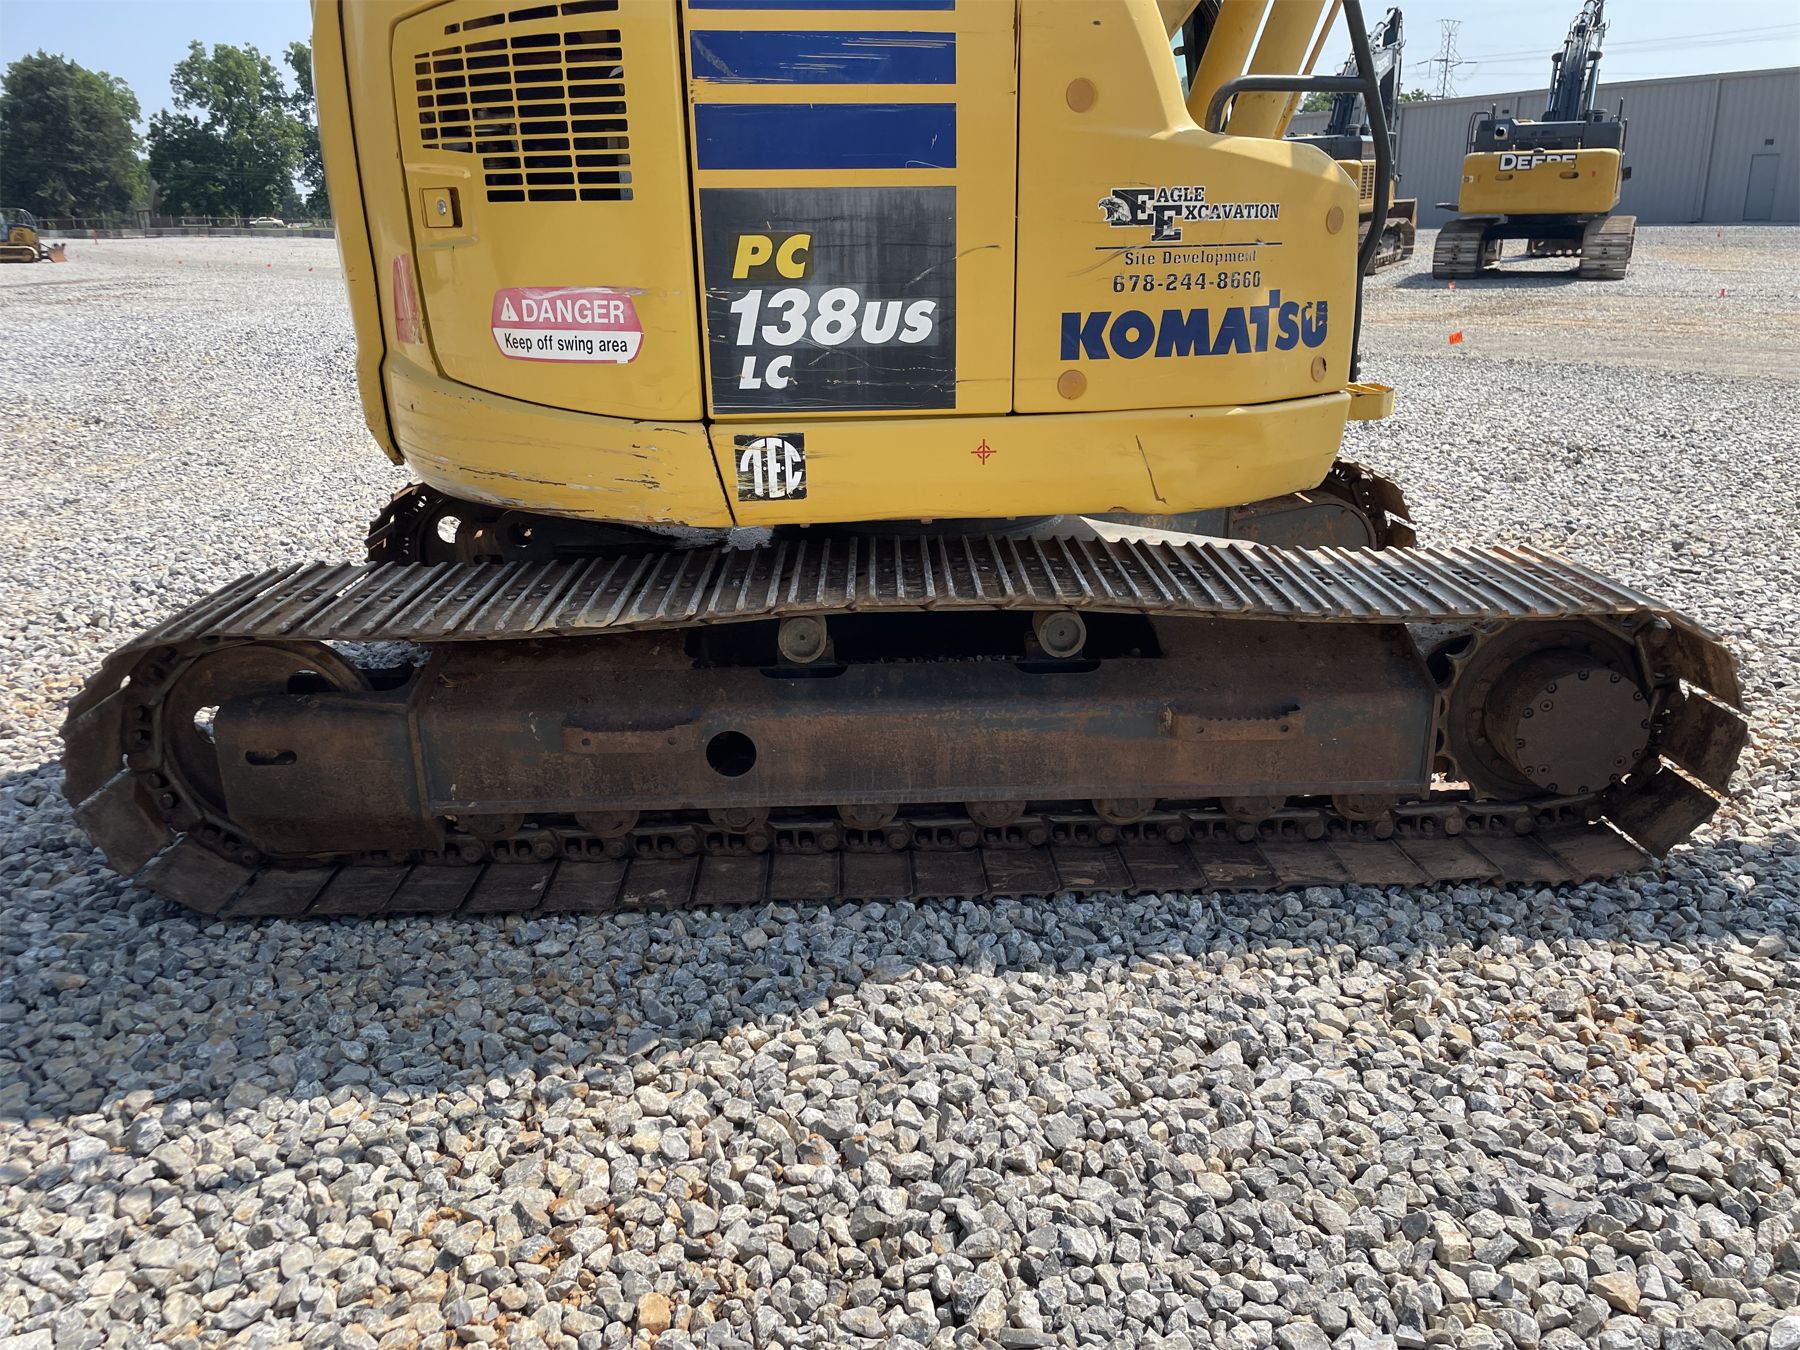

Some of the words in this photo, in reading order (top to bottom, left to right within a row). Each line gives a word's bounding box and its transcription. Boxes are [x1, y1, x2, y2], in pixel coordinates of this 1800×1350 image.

[1110, 187, 1205, 226] EAGLE
[1151, 203, 1280, 241] EXCAVATION
[732, 234, 811, 279] PC
[1124, 251, 1156, 266] Site
[1112, 270, 1262, 293] 678-244-8660
[521, 299, 625, 324] DANGER
[1059, 289, 1328, 361] KOMATSU
[504, 333, 533, 352] Keep
[536, 335, 553, 350] off
[557, 336, 593, 355] swing
[599, 340, 628, 353] area
[738, 355, 793, 390] LC
